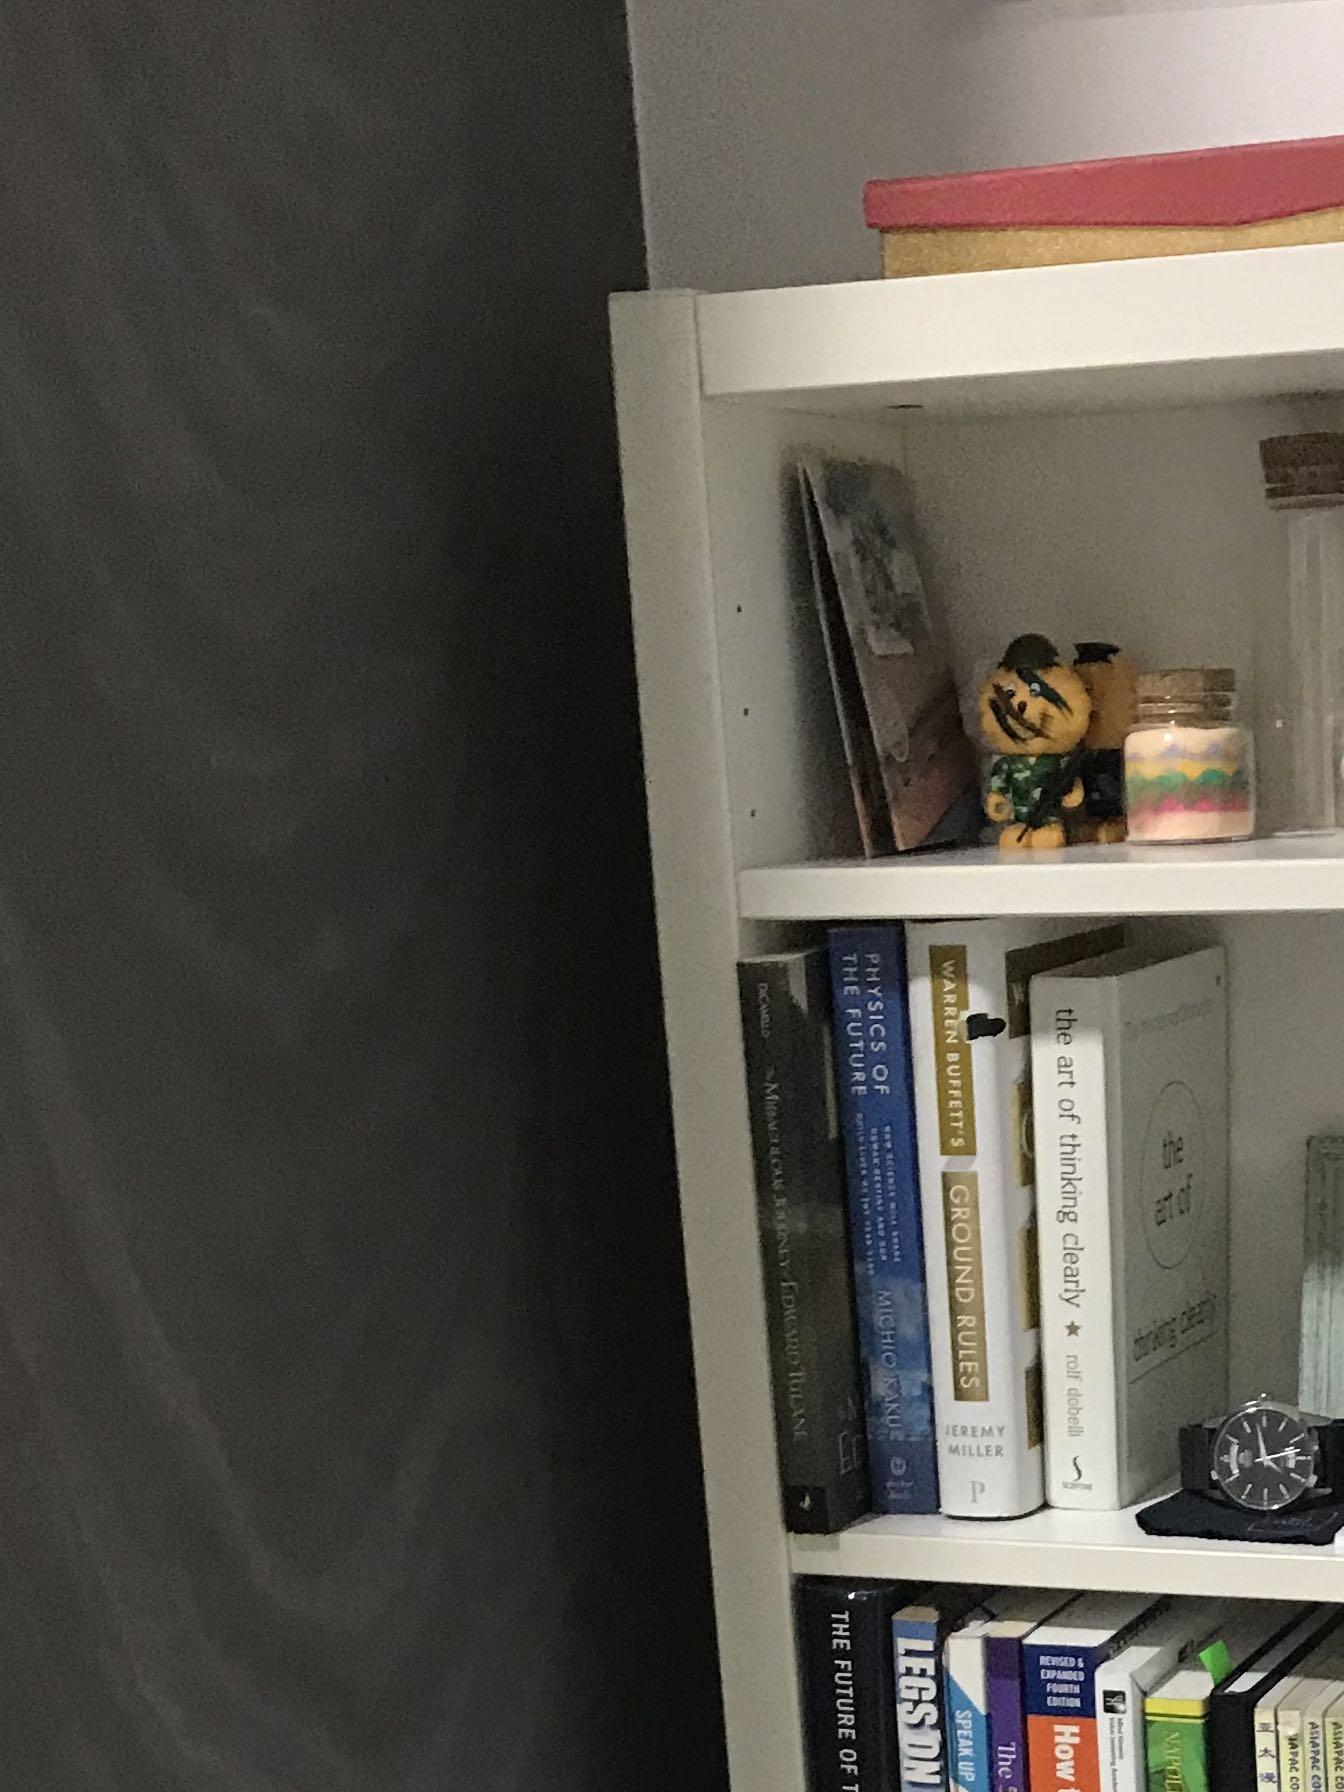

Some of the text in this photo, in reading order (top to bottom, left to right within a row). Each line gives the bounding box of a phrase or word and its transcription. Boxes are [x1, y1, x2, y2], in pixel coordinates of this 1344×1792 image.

[842, 953, 860, 996] THE
[865, 952, 889, 1096] PHYSICS OF
[845, 1008, 867, 1096] FUTURE
[941, 960, 966, 1147] WARREN BUFFETT'S
[1056, 1008, 1086, 1308] the art of thinking clearly
[948, 1184, 980, 1389] GROUND RULES
[876, 1289, 902, 1429] MICHIO KAKU
[1066, 1354, 1084, 1437] rolf dobelli
[944, 1424, 1005, 1438] JEREMY
[948, 1444, 1005, 1457] MILLER
[831, 1611, 851, 1651] THE
[896, 1637, 938, 1727] LEGS
[1039, 1655, 1076, 1668] REVISED
[1040, 1668, 1085, 1682] EXPANDED
[833, 1660, 856, 1740] FUTURE
[1046, 1682, 1081, 1694] FOURTH
[839, 1749, 858, 1776] OF
[899, 1735, 941, 1784] ON
[954, 1709, 976, 1782] SPEAK UP
[997, 1742, 1018, 1779] The
[1053, 1725, 1081, 1782] How
[1309, 1721, 1321, 1771] ASIAPAC
[1331, 1721, 1344, 1773] ASIAPAC
